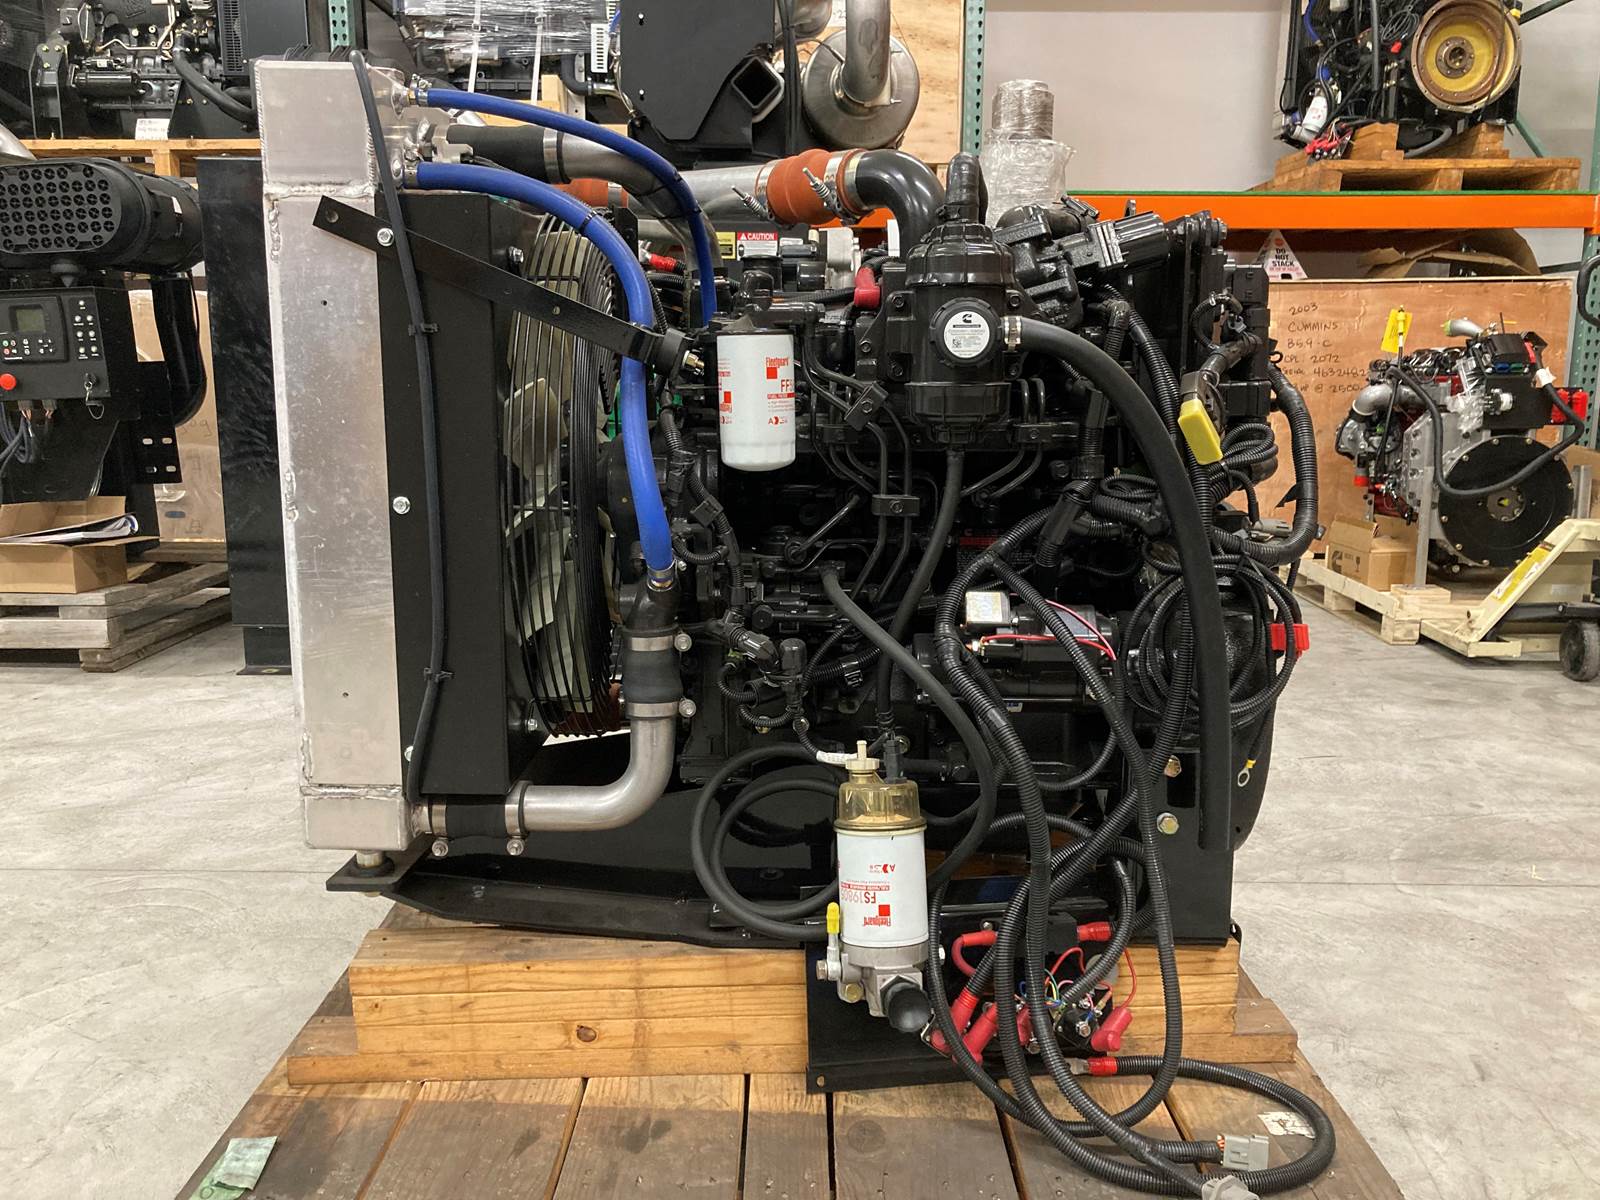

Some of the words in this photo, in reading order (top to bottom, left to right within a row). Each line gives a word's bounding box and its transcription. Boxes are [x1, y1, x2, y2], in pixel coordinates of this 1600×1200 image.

[747, 232, 775, 241] CAUTION
[1288, 302, 1319, 315] 2003
[1287, 320, 1339, 332] CUMMINS
[1309, 353, 1341, 364] 2072
